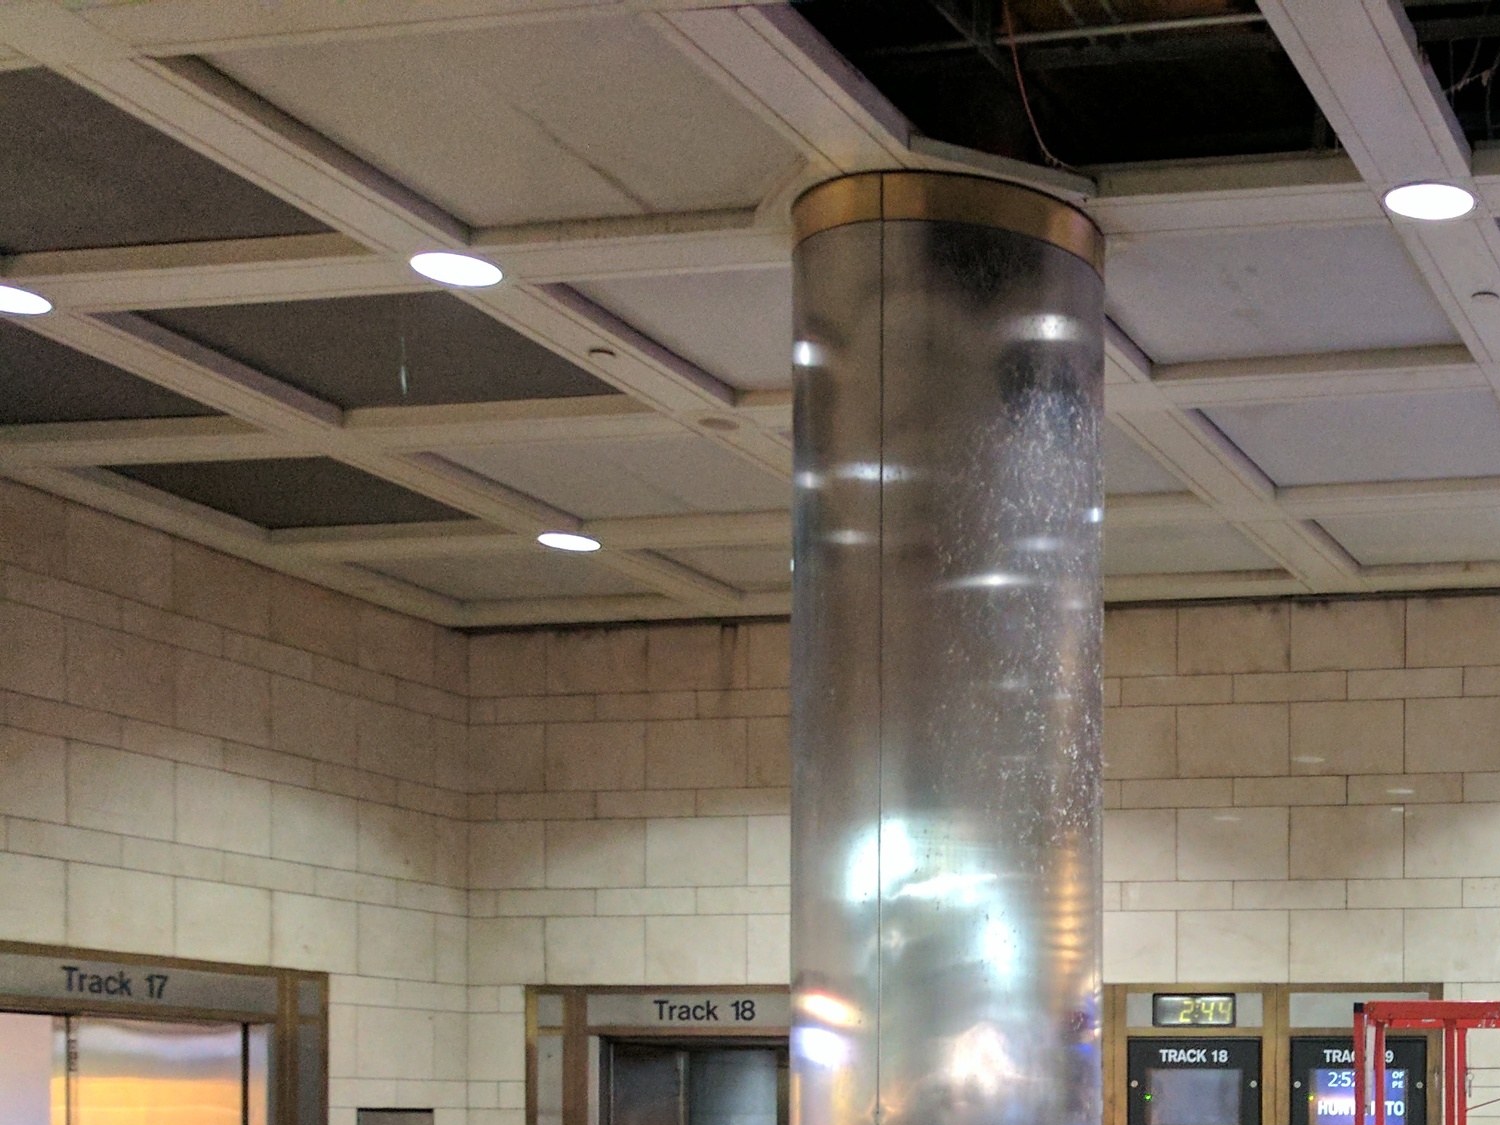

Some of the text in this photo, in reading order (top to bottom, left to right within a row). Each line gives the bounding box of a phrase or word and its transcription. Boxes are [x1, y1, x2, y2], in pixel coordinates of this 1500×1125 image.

[61, 965, 169, 1000] Track 17
[653, 1000, 756, 1021] Track 18
[1179, 1000, 1233, 1023] 2:44
[1159, 1049, 1229, 1063] TRACK 18
[1323, 1049, 1394, 1063] TRA 9
